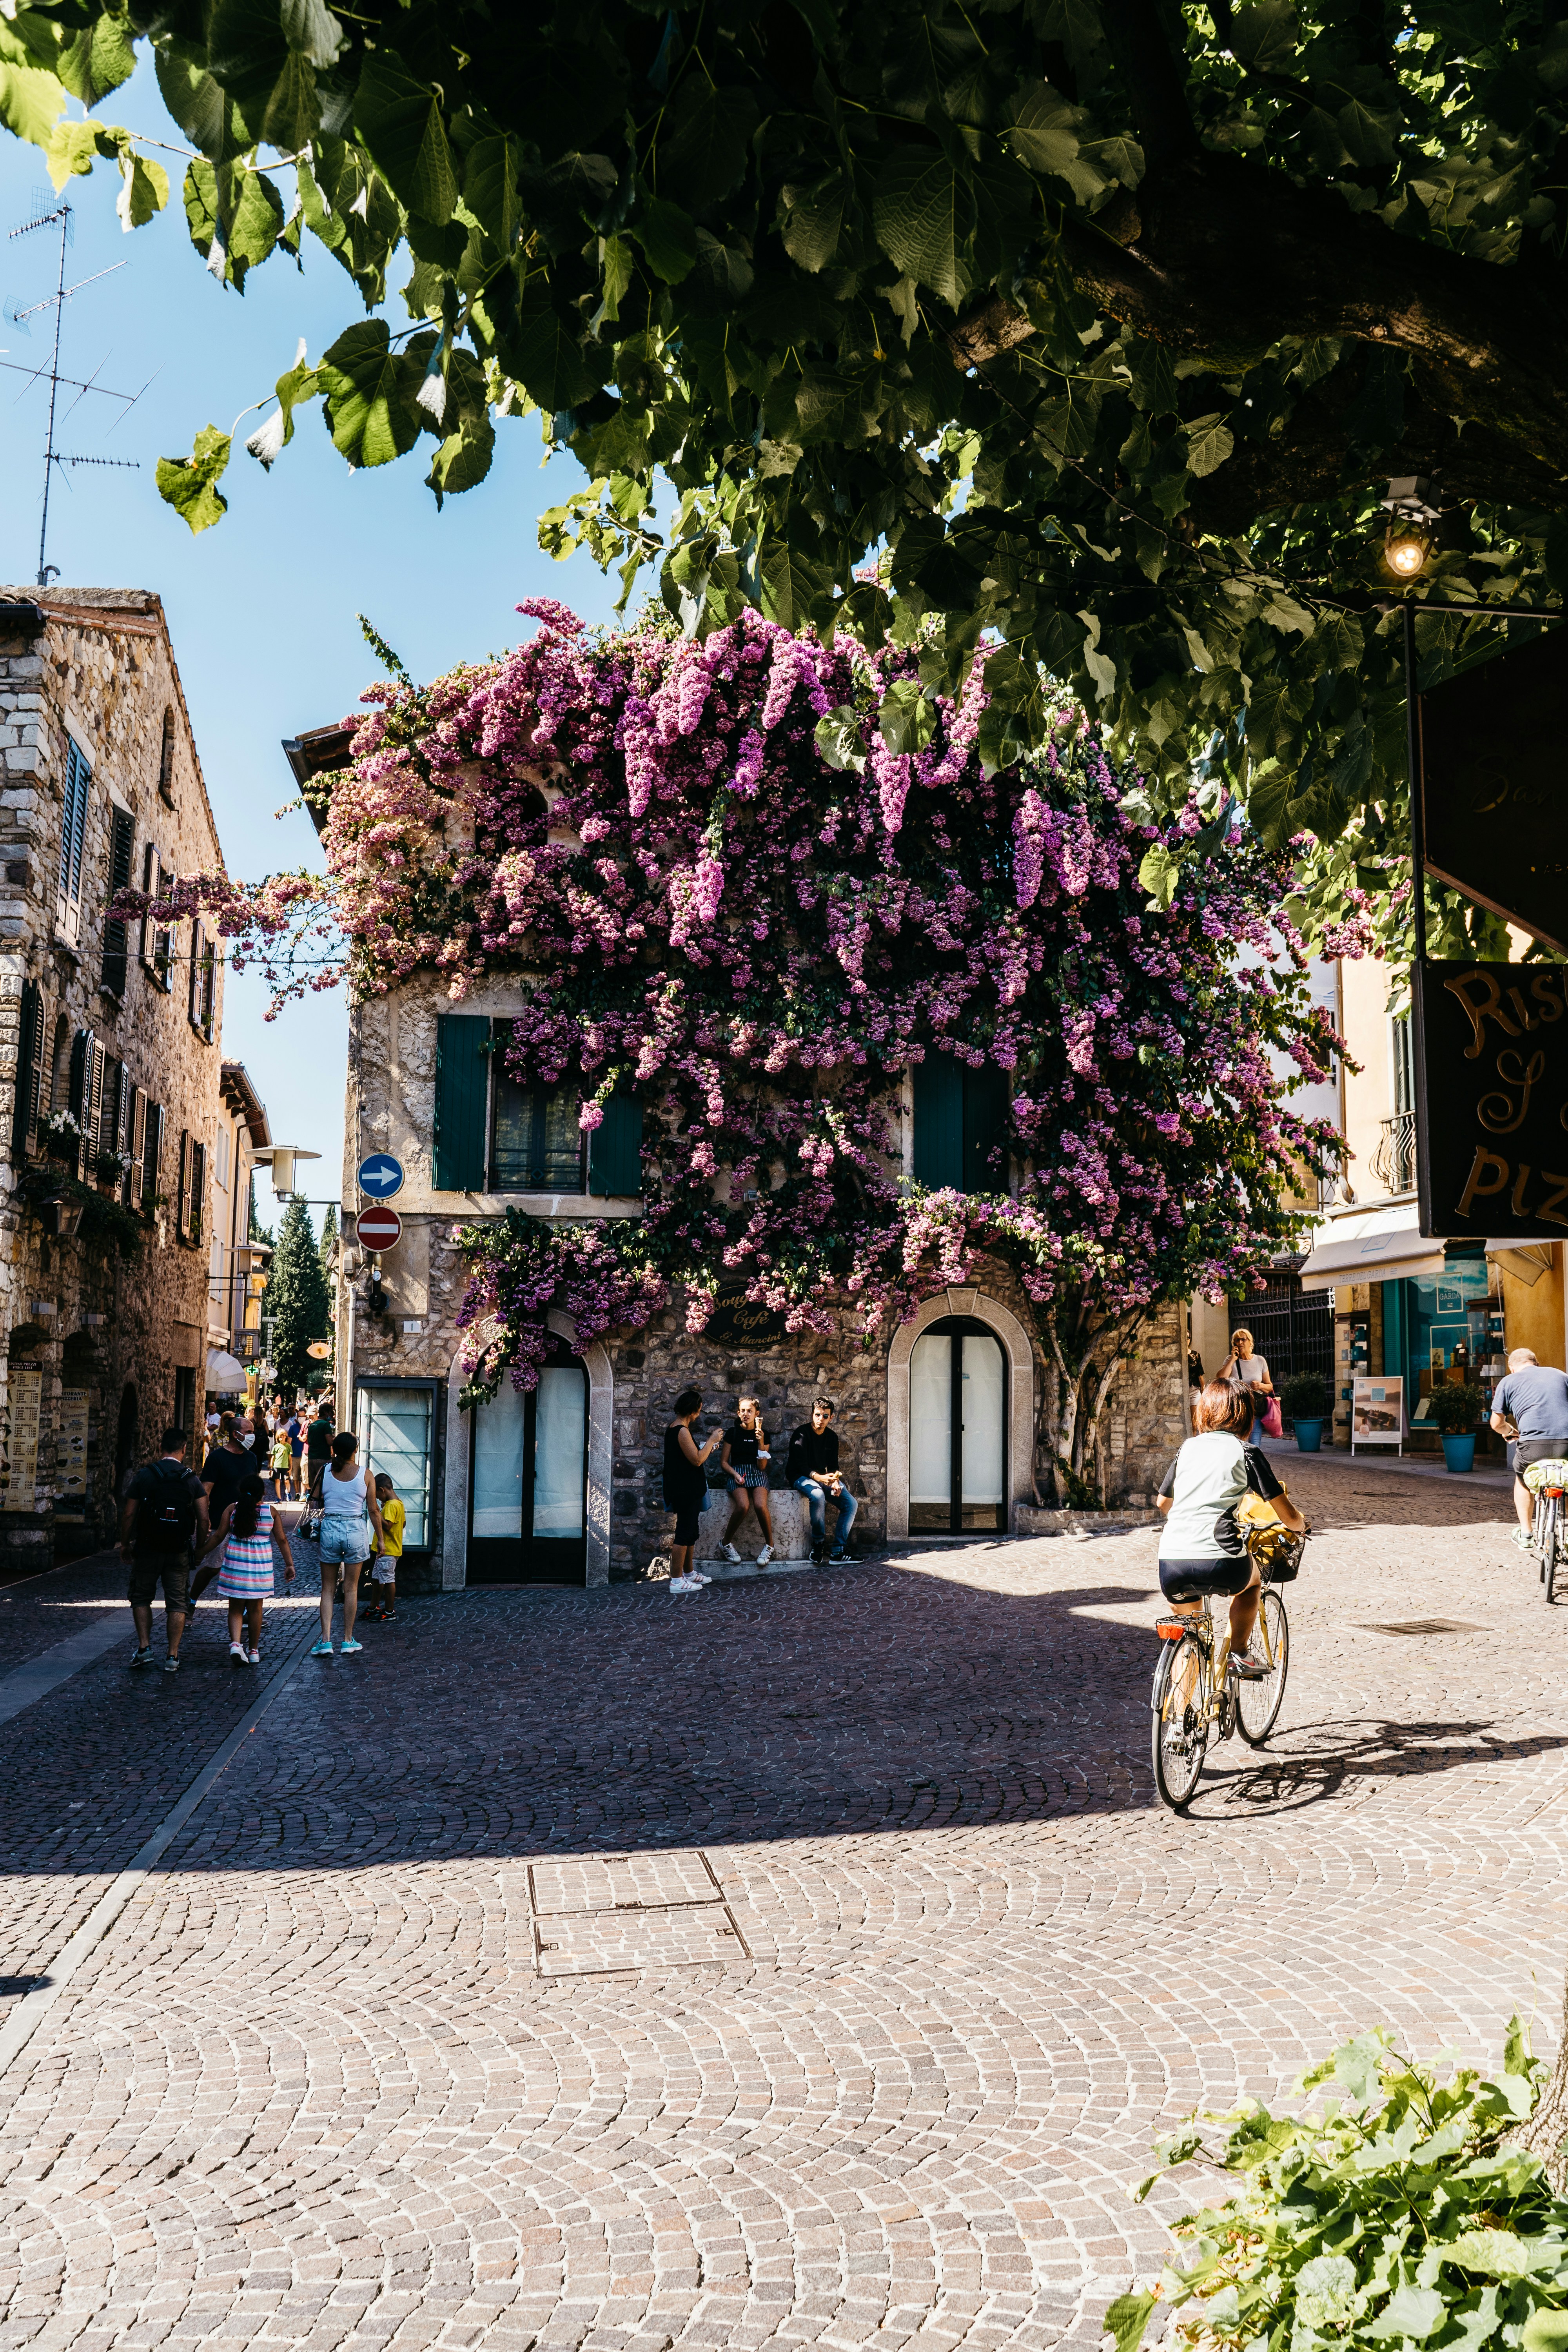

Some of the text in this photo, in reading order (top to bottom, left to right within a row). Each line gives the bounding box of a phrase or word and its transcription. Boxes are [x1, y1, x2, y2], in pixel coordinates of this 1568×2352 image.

[1339, 1269, 1386, 1283] TERRE DEL GARDA
[735, 1331, 782, 1344] Mancini
